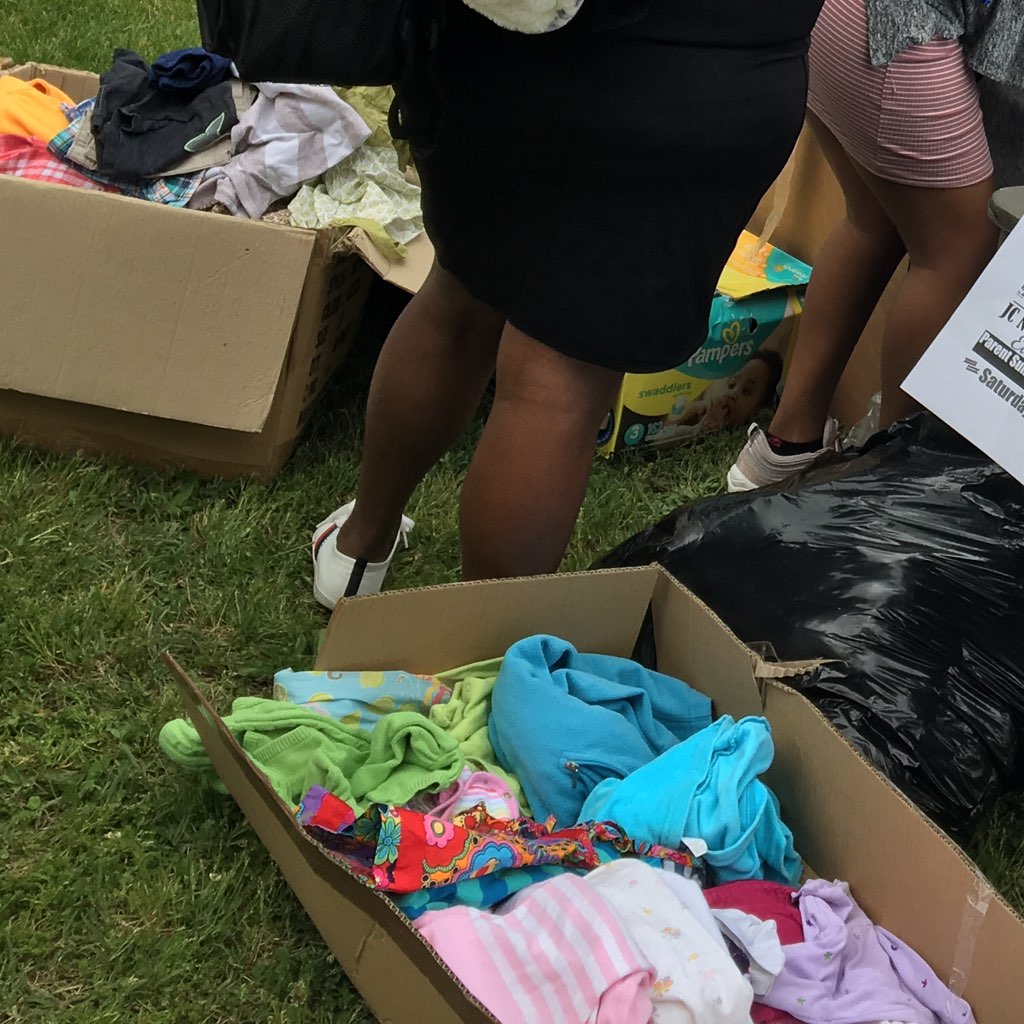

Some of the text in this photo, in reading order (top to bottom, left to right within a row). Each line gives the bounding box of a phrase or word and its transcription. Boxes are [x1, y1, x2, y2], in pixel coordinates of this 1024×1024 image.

[998, 302, 1021, 323] JC
[978, 331, 1012, 362] Parent
[639, 382, 692, 399] swaddlers
[630, 425, 640, 439] 3
